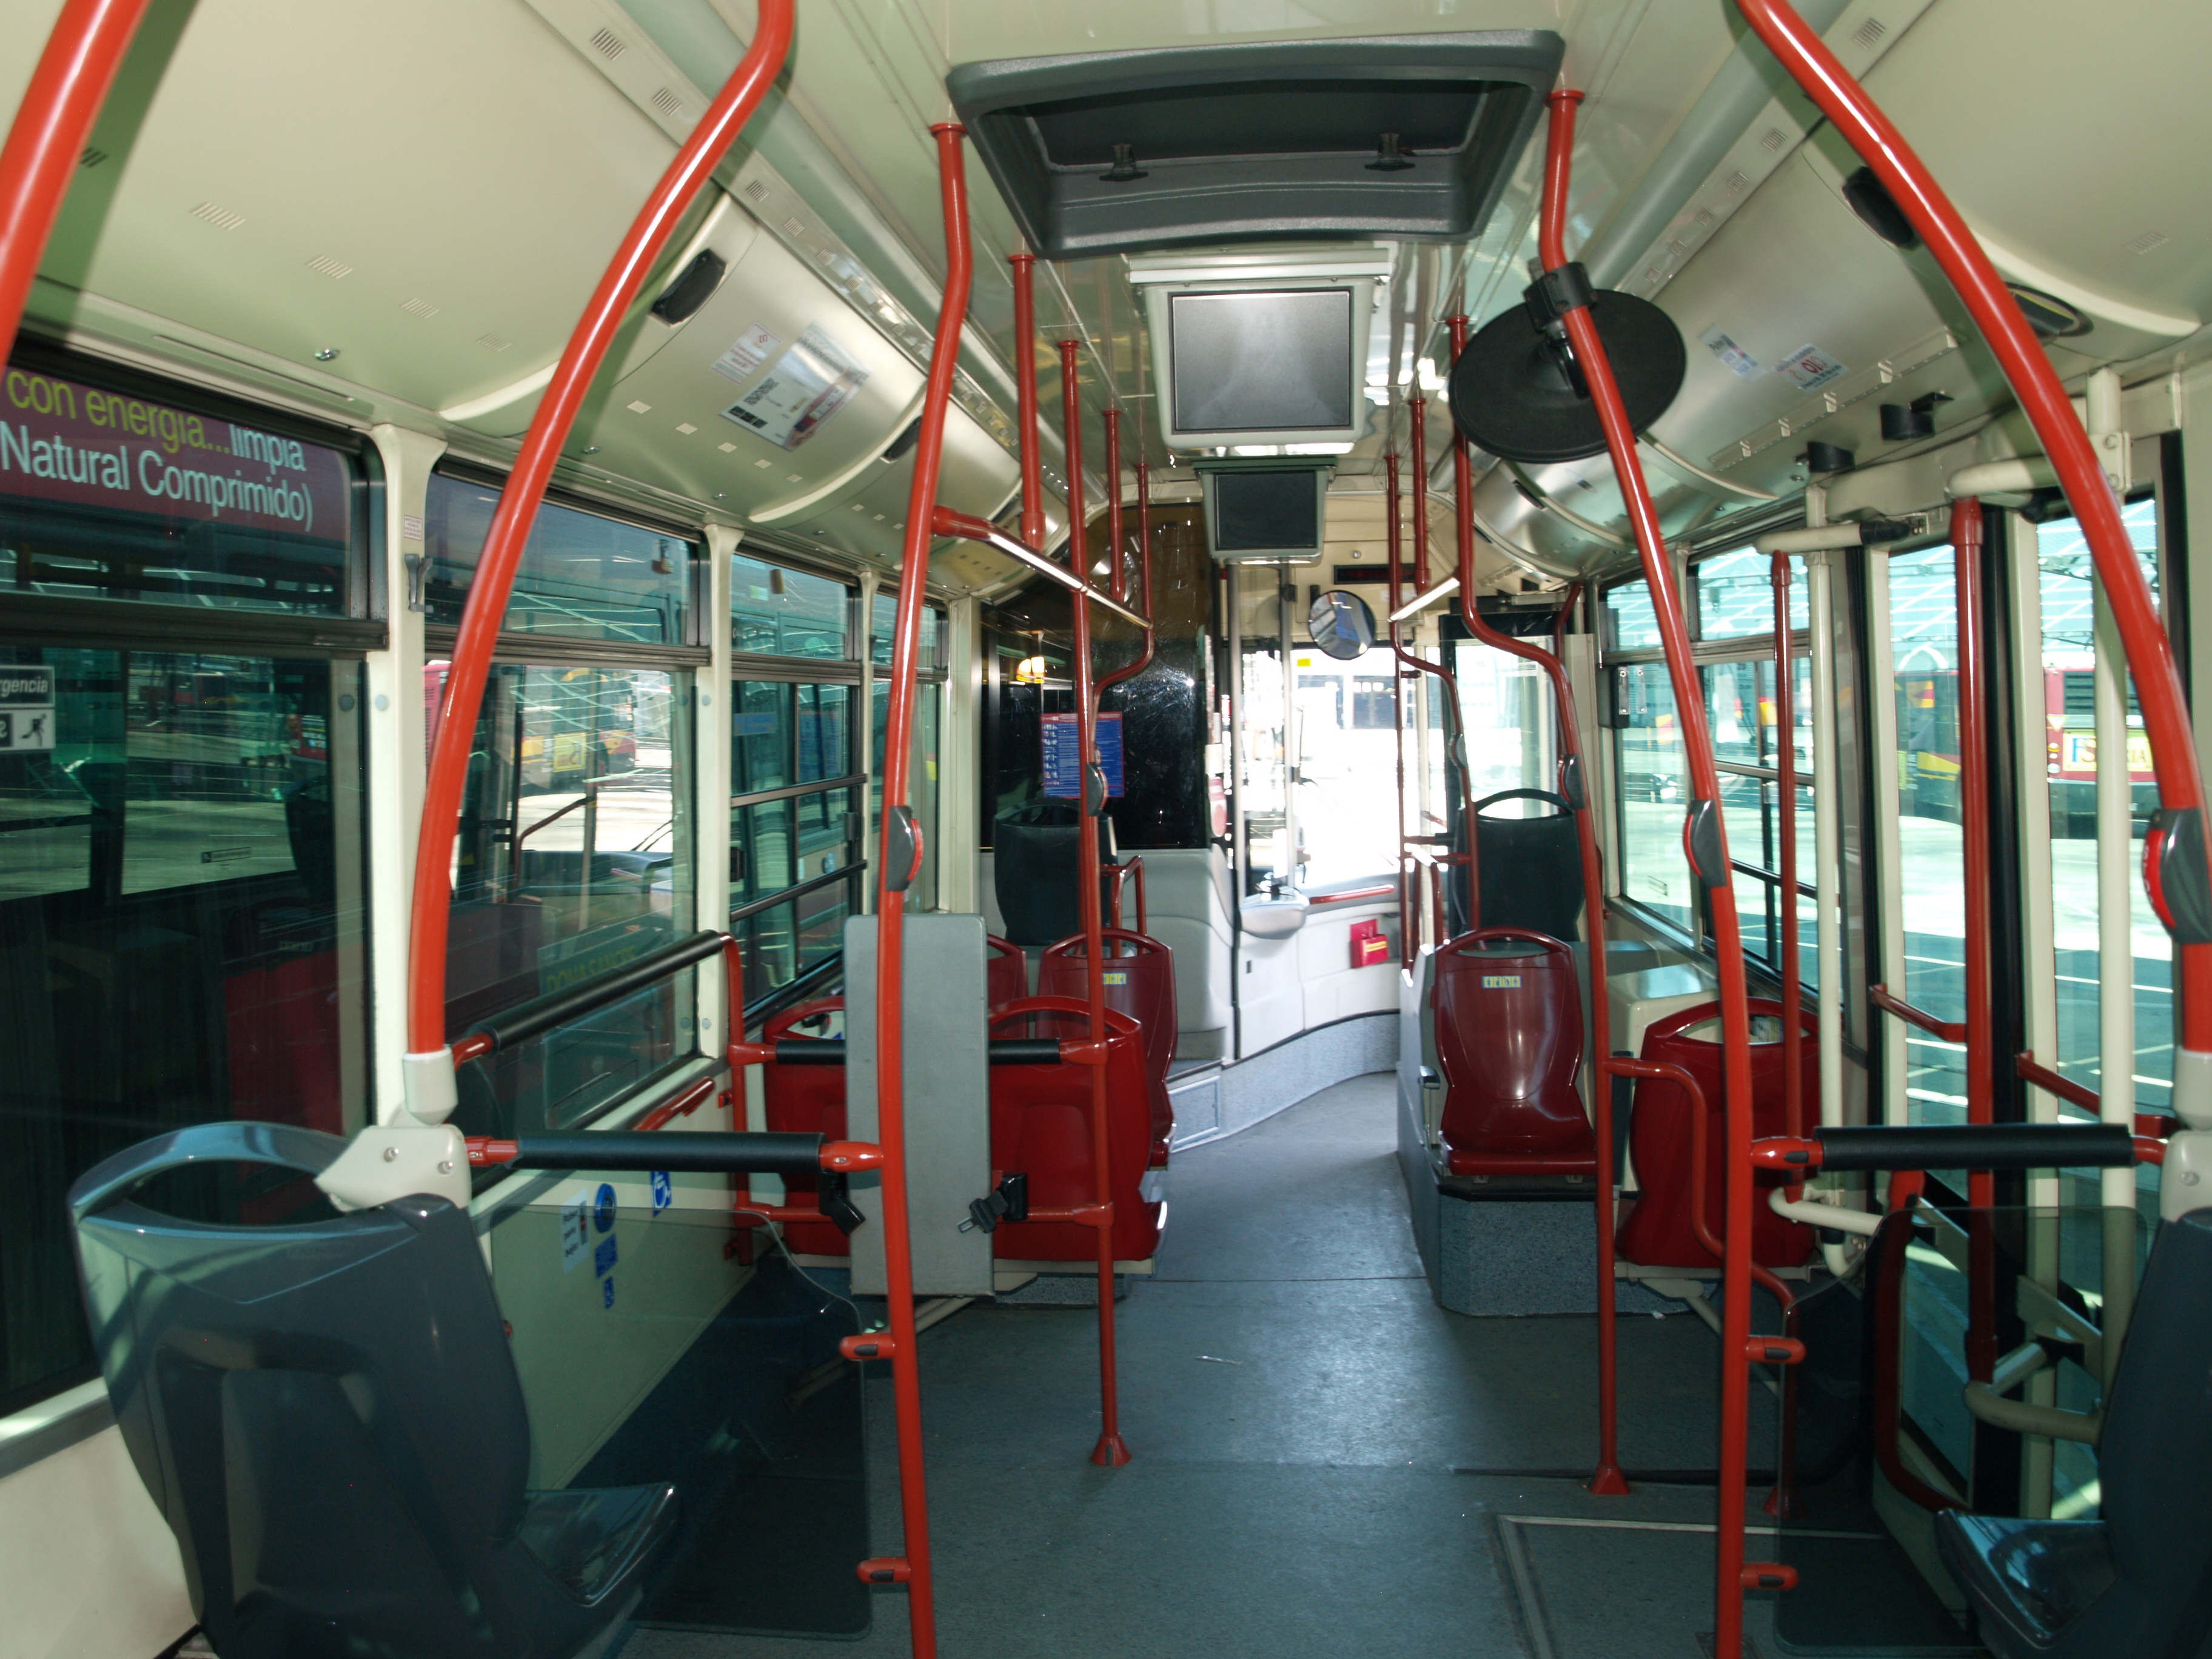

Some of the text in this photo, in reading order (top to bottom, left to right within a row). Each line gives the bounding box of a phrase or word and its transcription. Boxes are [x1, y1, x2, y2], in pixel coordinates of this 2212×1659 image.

[7, 371, 77, 419] con
[0, 421, 313, 532] Natural Comprimido)
